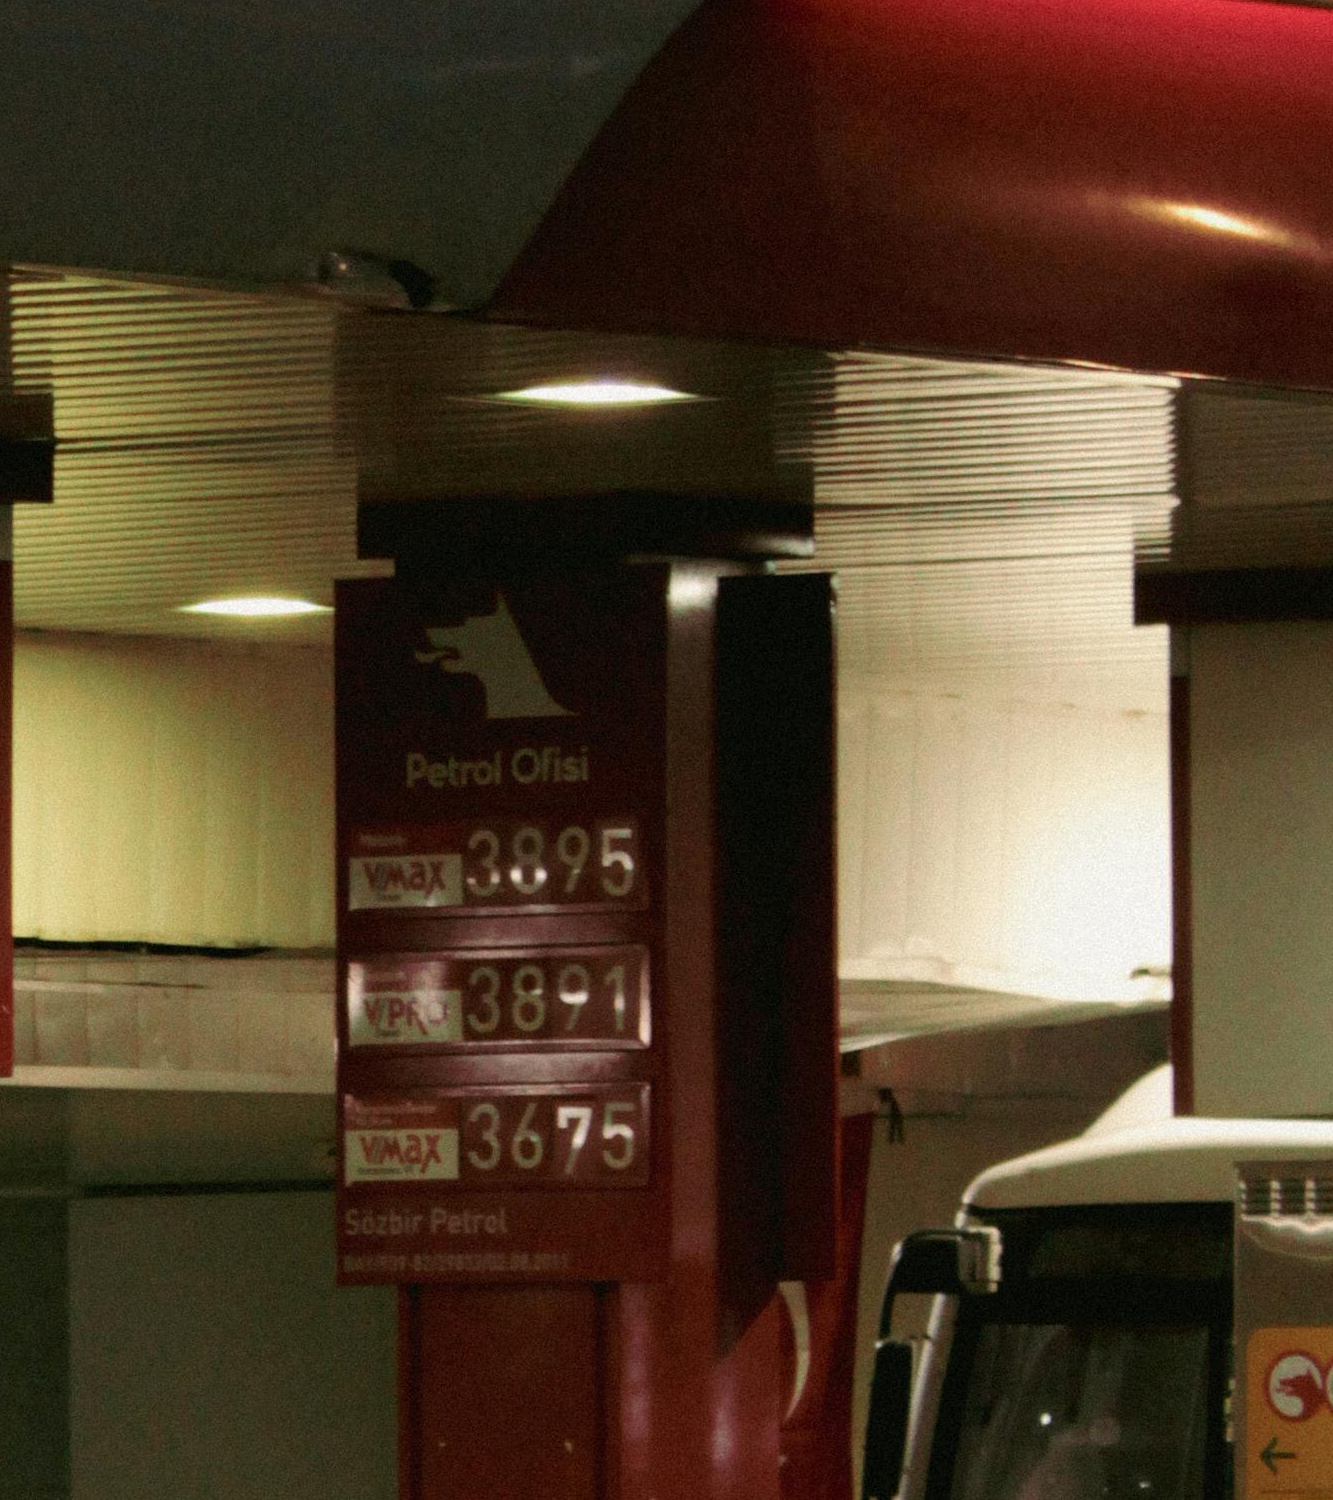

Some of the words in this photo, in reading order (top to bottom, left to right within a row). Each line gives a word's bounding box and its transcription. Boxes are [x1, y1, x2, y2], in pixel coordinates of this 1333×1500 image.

[405, 749, 503, 789] Petrol
[511, 744, 590, 785] Ofisi
[466, 826, 635, 897] 3895
[466, 962, 628, 1034] 3891
[466, 1101, 636, 1175] 3675
[429, 1205, 509, 1235] Petrol
